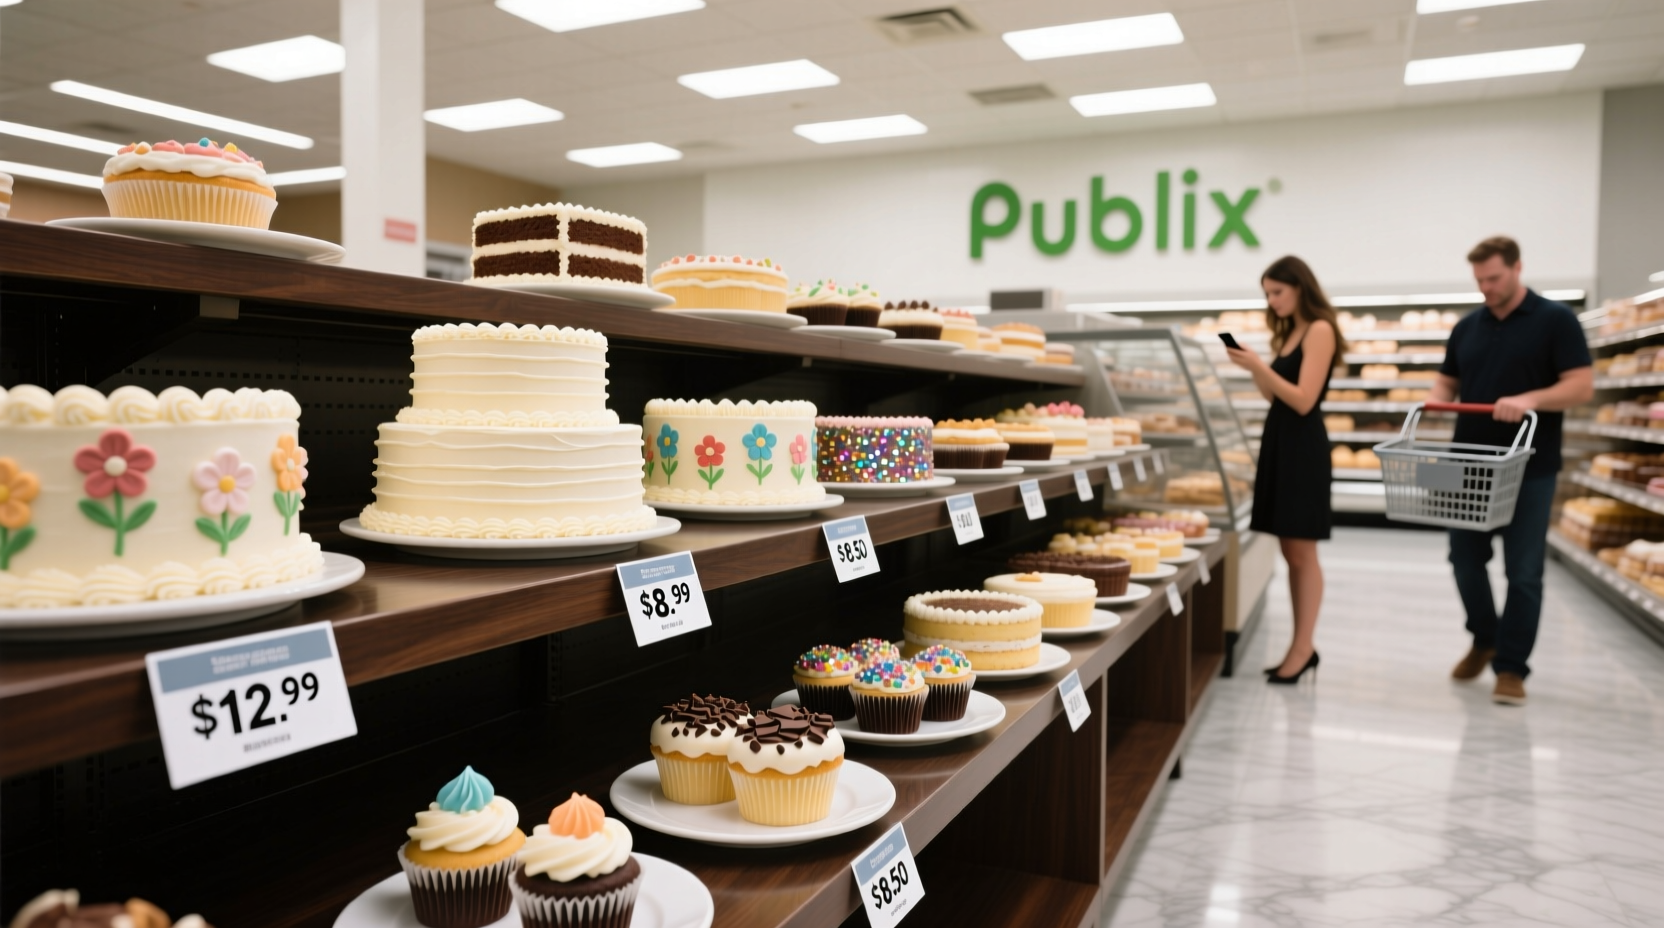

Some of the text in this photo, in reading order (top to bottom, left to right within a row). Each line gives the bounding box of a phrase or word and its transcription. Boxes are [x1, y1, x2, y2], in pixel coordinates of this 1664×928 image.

[970, 168, 1261, 259] Publix
[639, 582, 691, 620] $8.99
[191, 671, 320, 740] $12.99
[870, 860, 909, 910] $8.50
